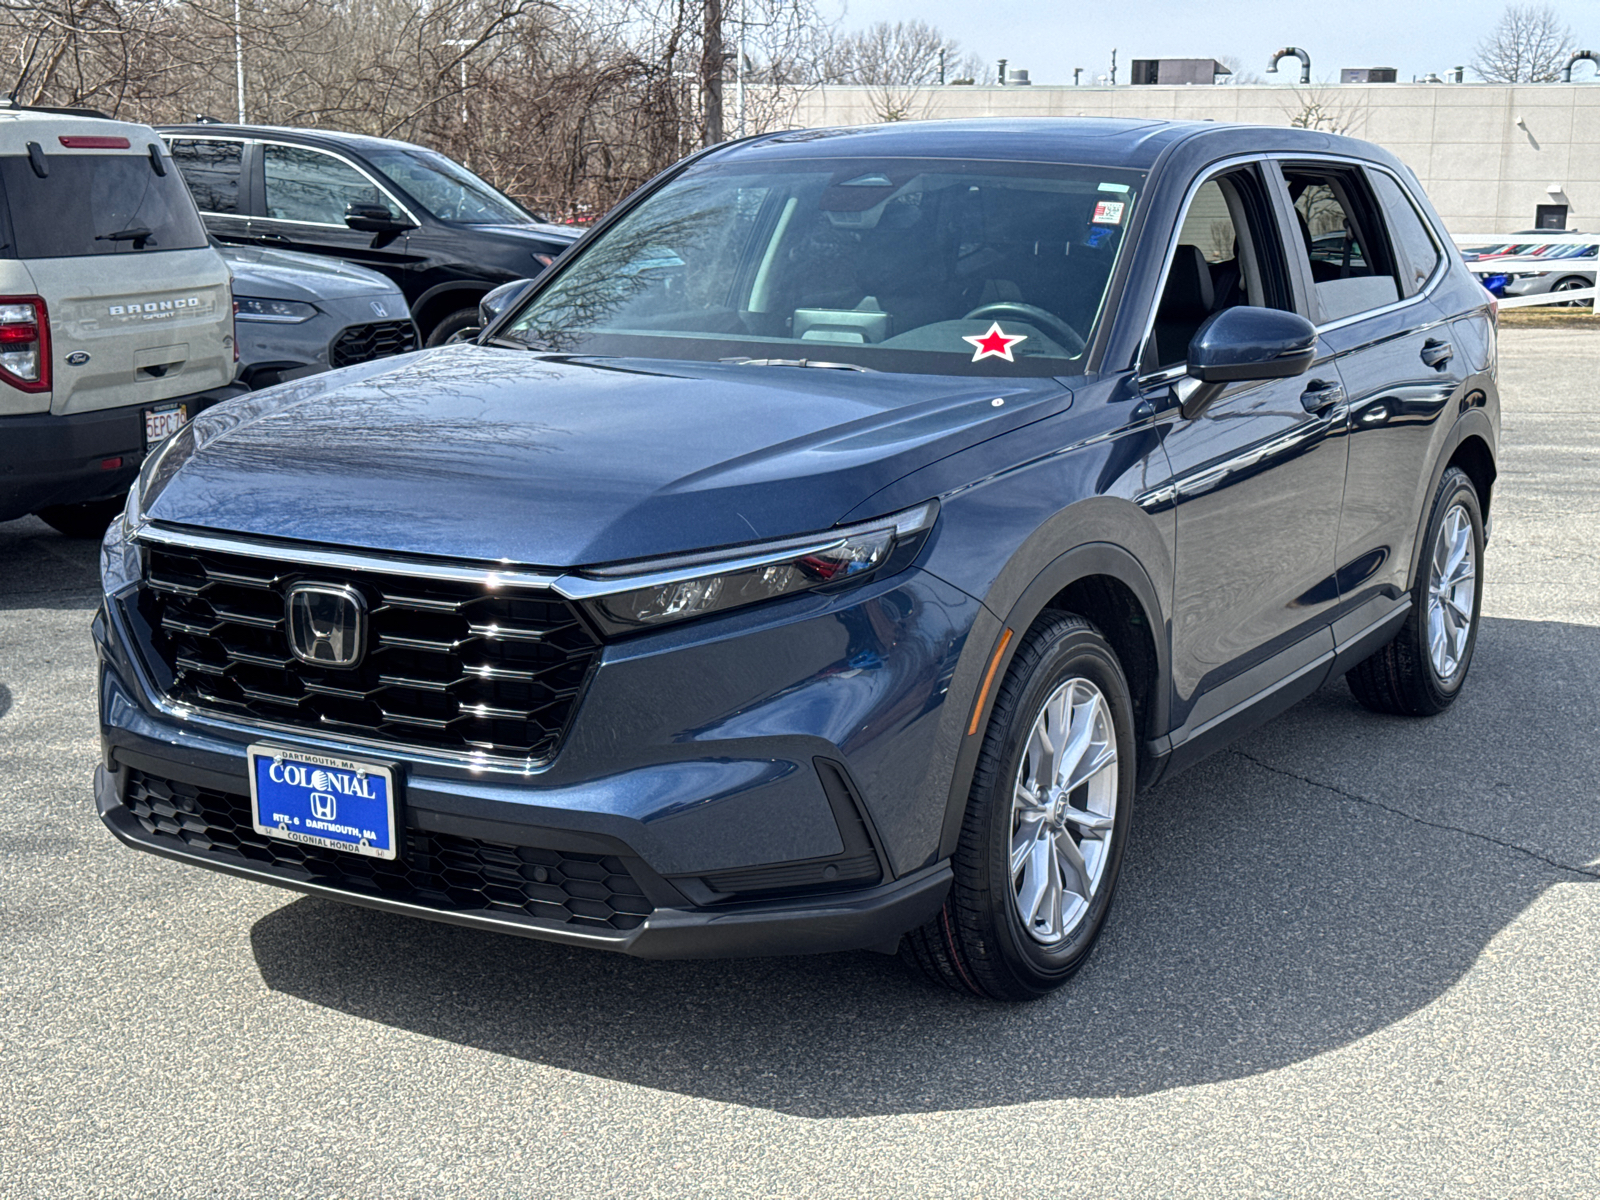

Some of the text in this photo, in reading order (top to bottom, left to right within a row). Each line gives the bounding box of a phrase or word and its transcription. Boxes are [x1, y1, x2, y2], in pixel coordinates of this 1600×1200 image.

[109, 297, 199, 315] BRONCO
[142, 311, 175, 320] SPORT
[282, 752, 355, 769] DARTMOUTH, MA
[269, 763, 376, 799] COLONIAL
[273, 813, 377, 840] RTE. 6 DARTMOUTH, MA
[287, 832, 360, 853] COLONIAL HONDA
